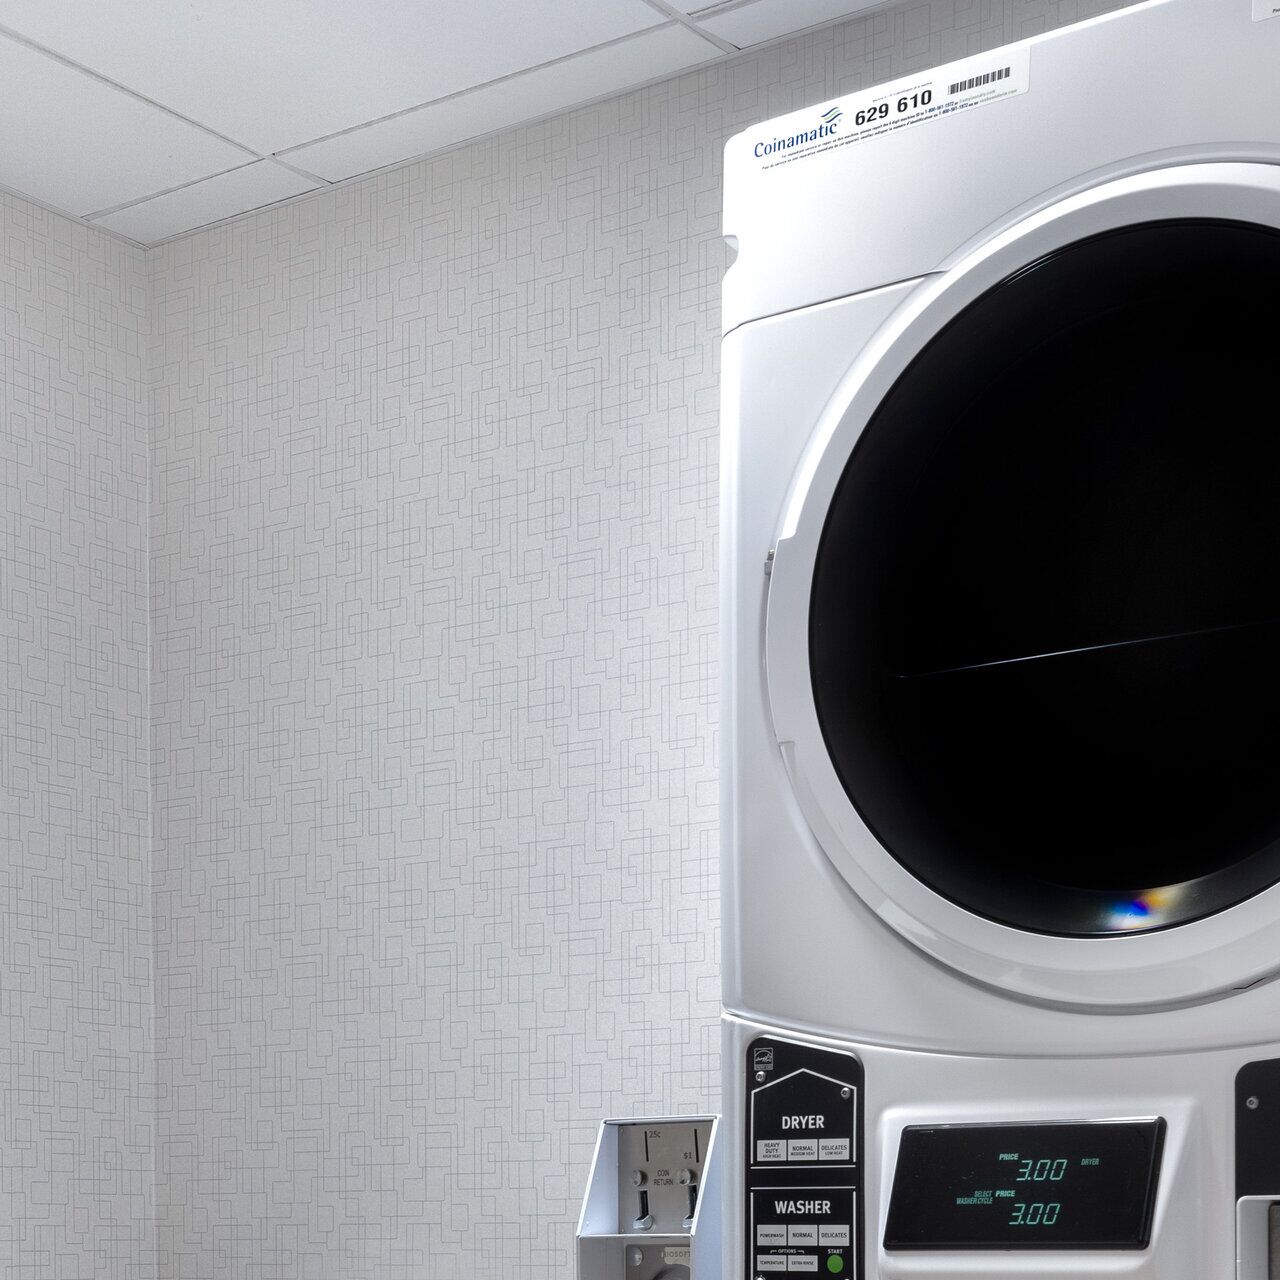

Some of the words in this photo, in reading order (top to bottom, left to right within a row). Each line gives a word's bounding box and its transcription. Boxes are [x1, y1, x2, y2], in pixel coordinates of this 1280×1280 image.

[855, 103, 889, 126] 629
[897, 89, 932, 113] 610
[754, 122, 837, 158] Coinamatic
[782, 1115, 825, 1130] DRYER
[683, 1152, 692, 1160] $1
[1081, 1158, 1100, 1166] DRYER
[657, 1169, 670, 1178] COIN
[1016, 1159, 1068, 1181] 3.00
[653, 1178, 674, 1186] RETURN
[774, 1200, 831, 1214] WASHER
[1009, 1203, 1061, 1225] 3.00
